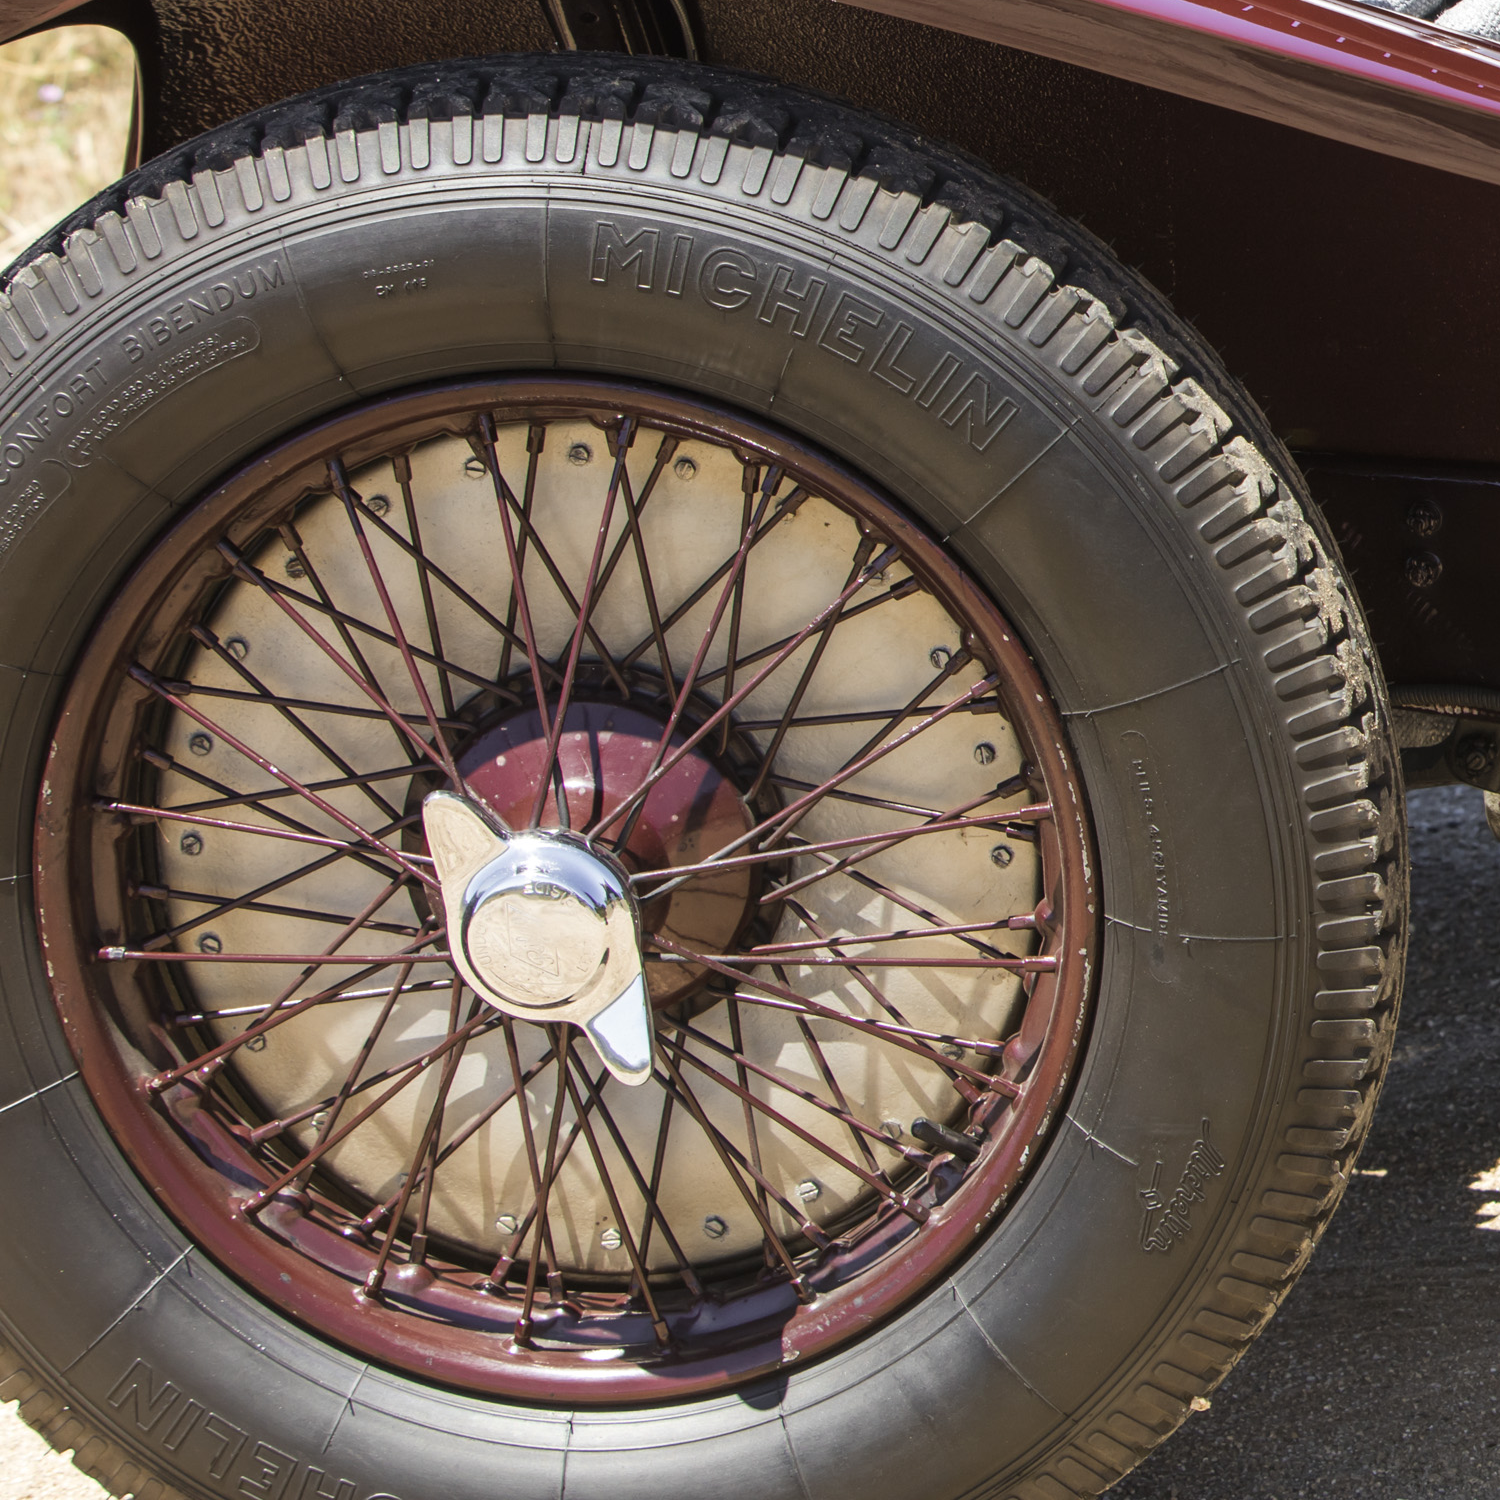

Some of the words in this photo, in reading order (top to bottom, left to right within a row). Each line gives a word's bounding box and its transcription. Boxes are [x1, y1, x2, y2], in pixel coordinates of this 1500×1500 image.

[119, 260, 286, 364] BIBENDUM
[589, 220, 1020, 452] MICHELIN
[93, 399, 120, 425] LOAD
[0, 492, 48, 554] ESCRIPTION
[1140, 1117, 1226, 1251] Michelin
[106, 1358, 402, 1500] ELIN
